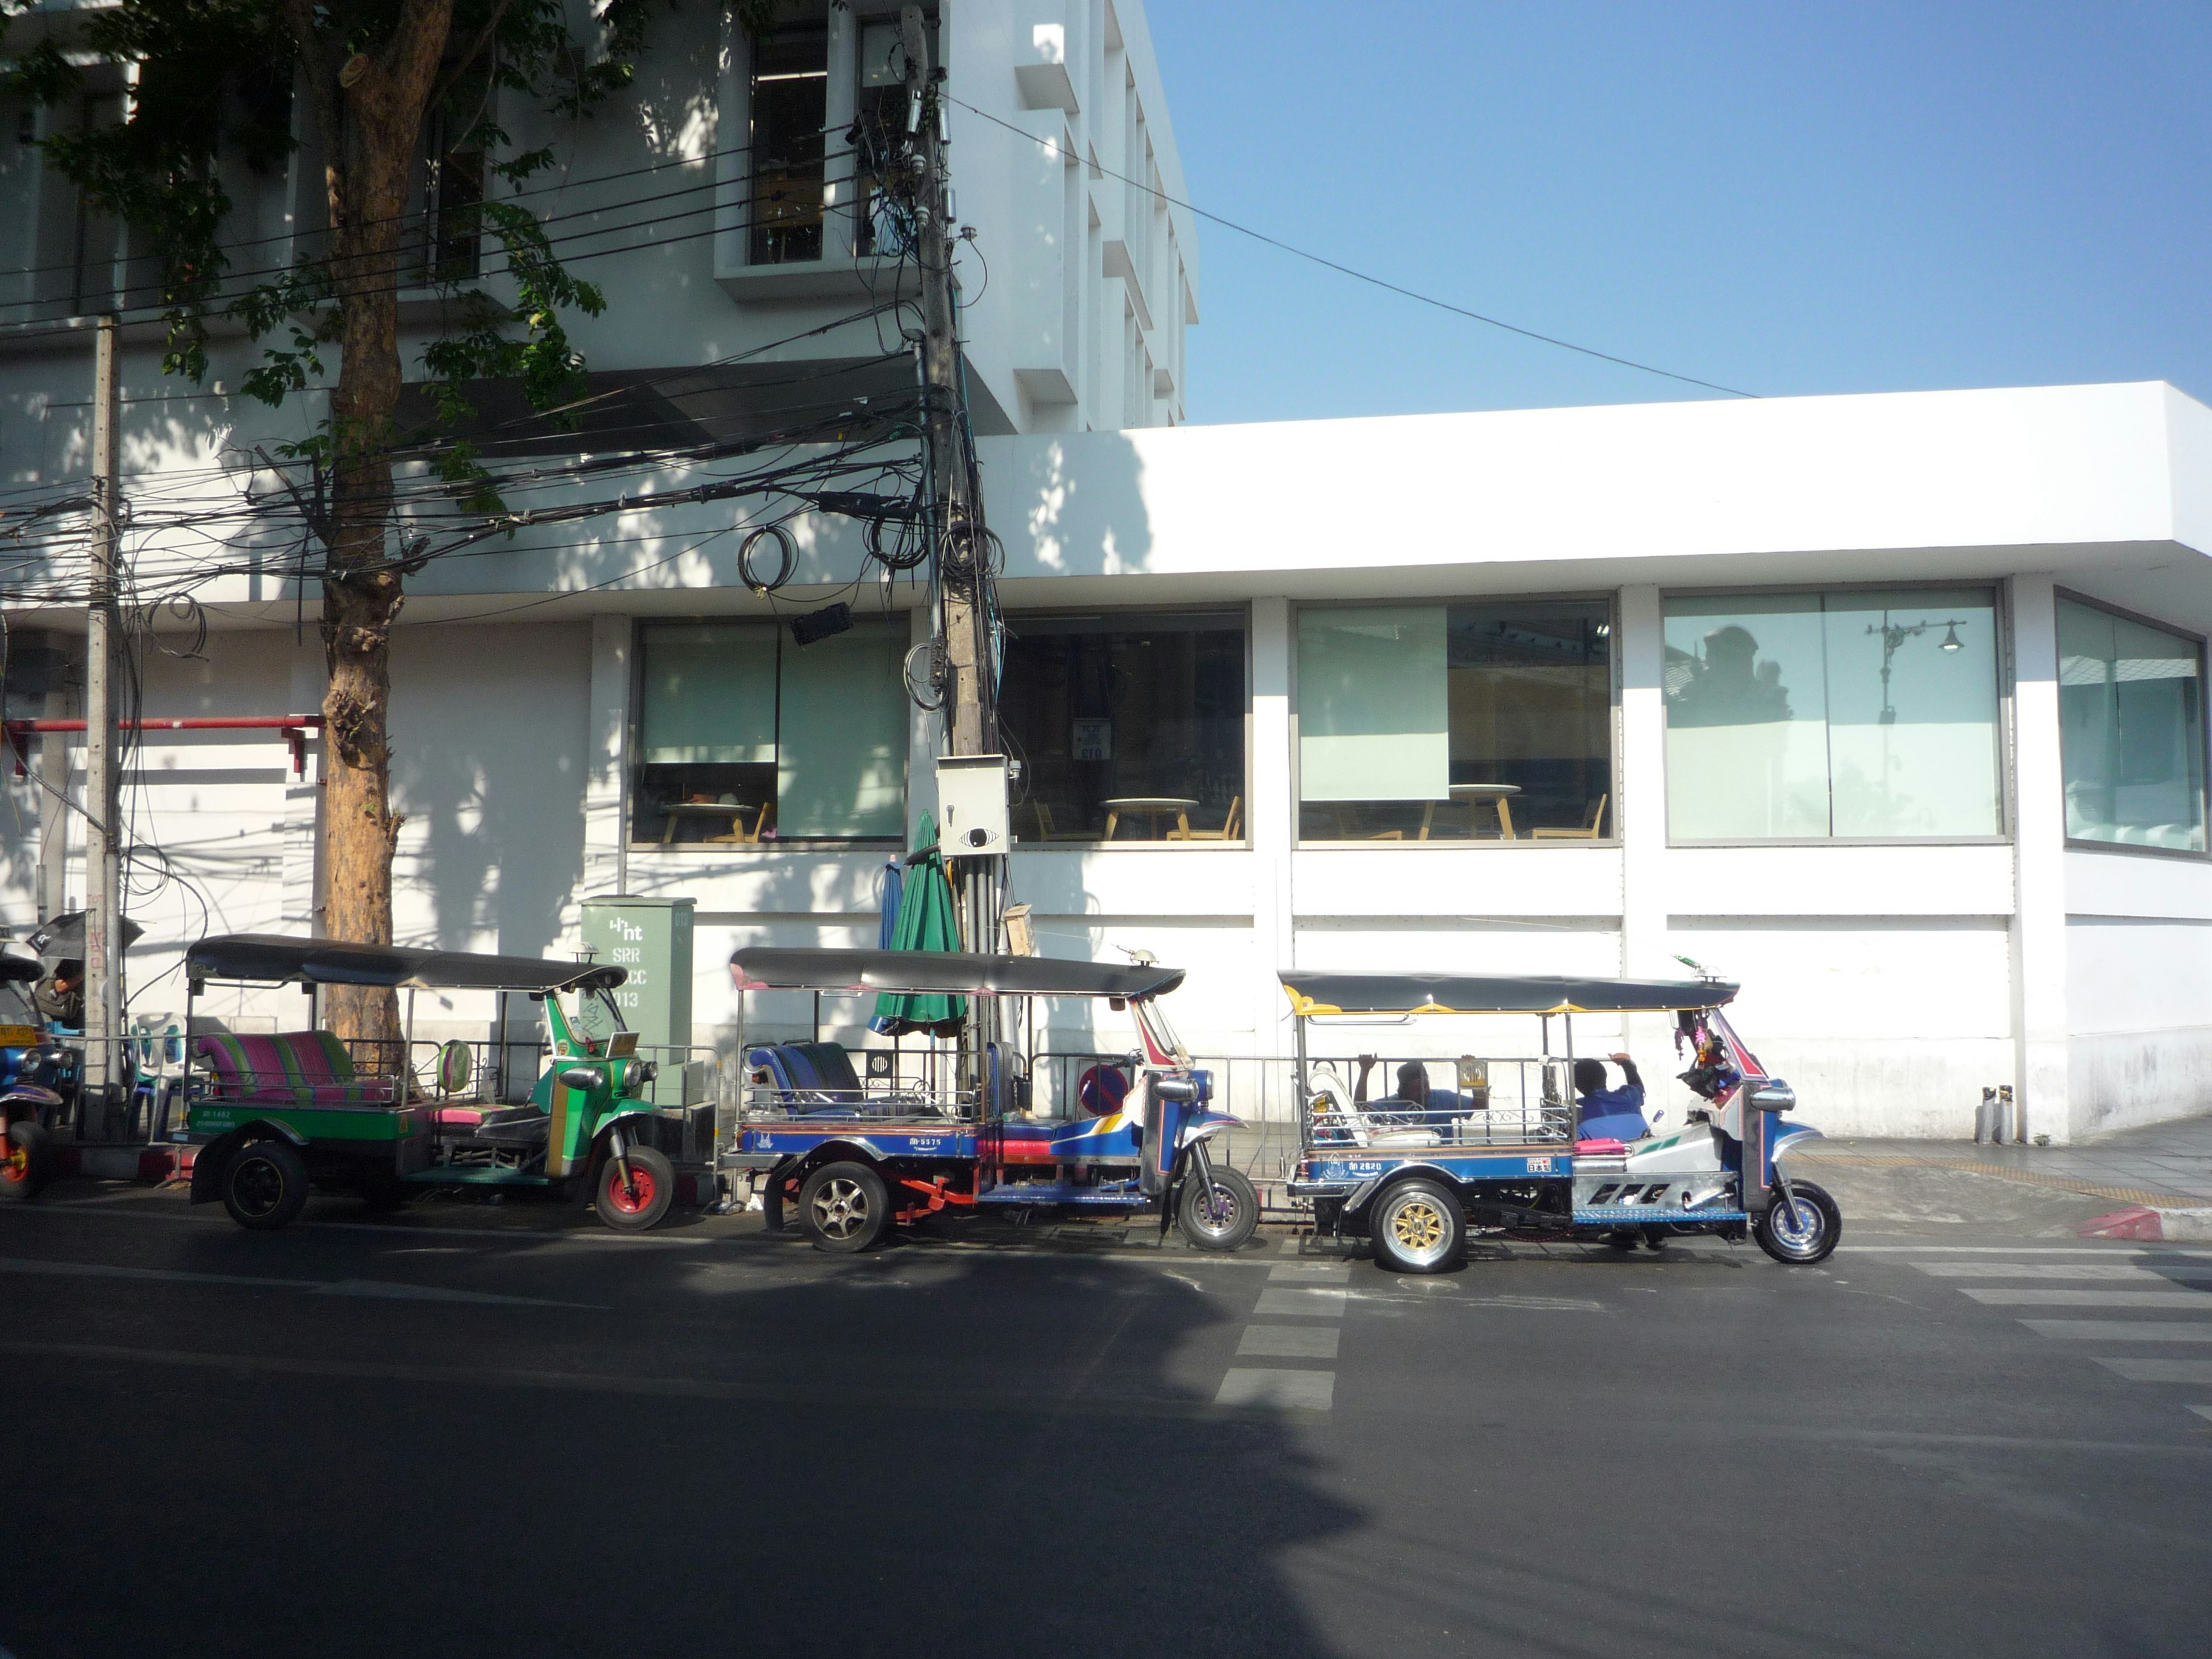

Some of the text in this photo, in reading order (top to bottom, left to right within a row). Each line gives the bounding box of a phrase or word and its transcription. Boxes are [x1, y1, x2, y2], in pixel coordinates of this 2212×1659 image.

[675, 912, 688, 927] 013
[623, 925, 643, 940] nt
[612, 947, 640, 962] SRR
[625, 969, 646, 985] CC
